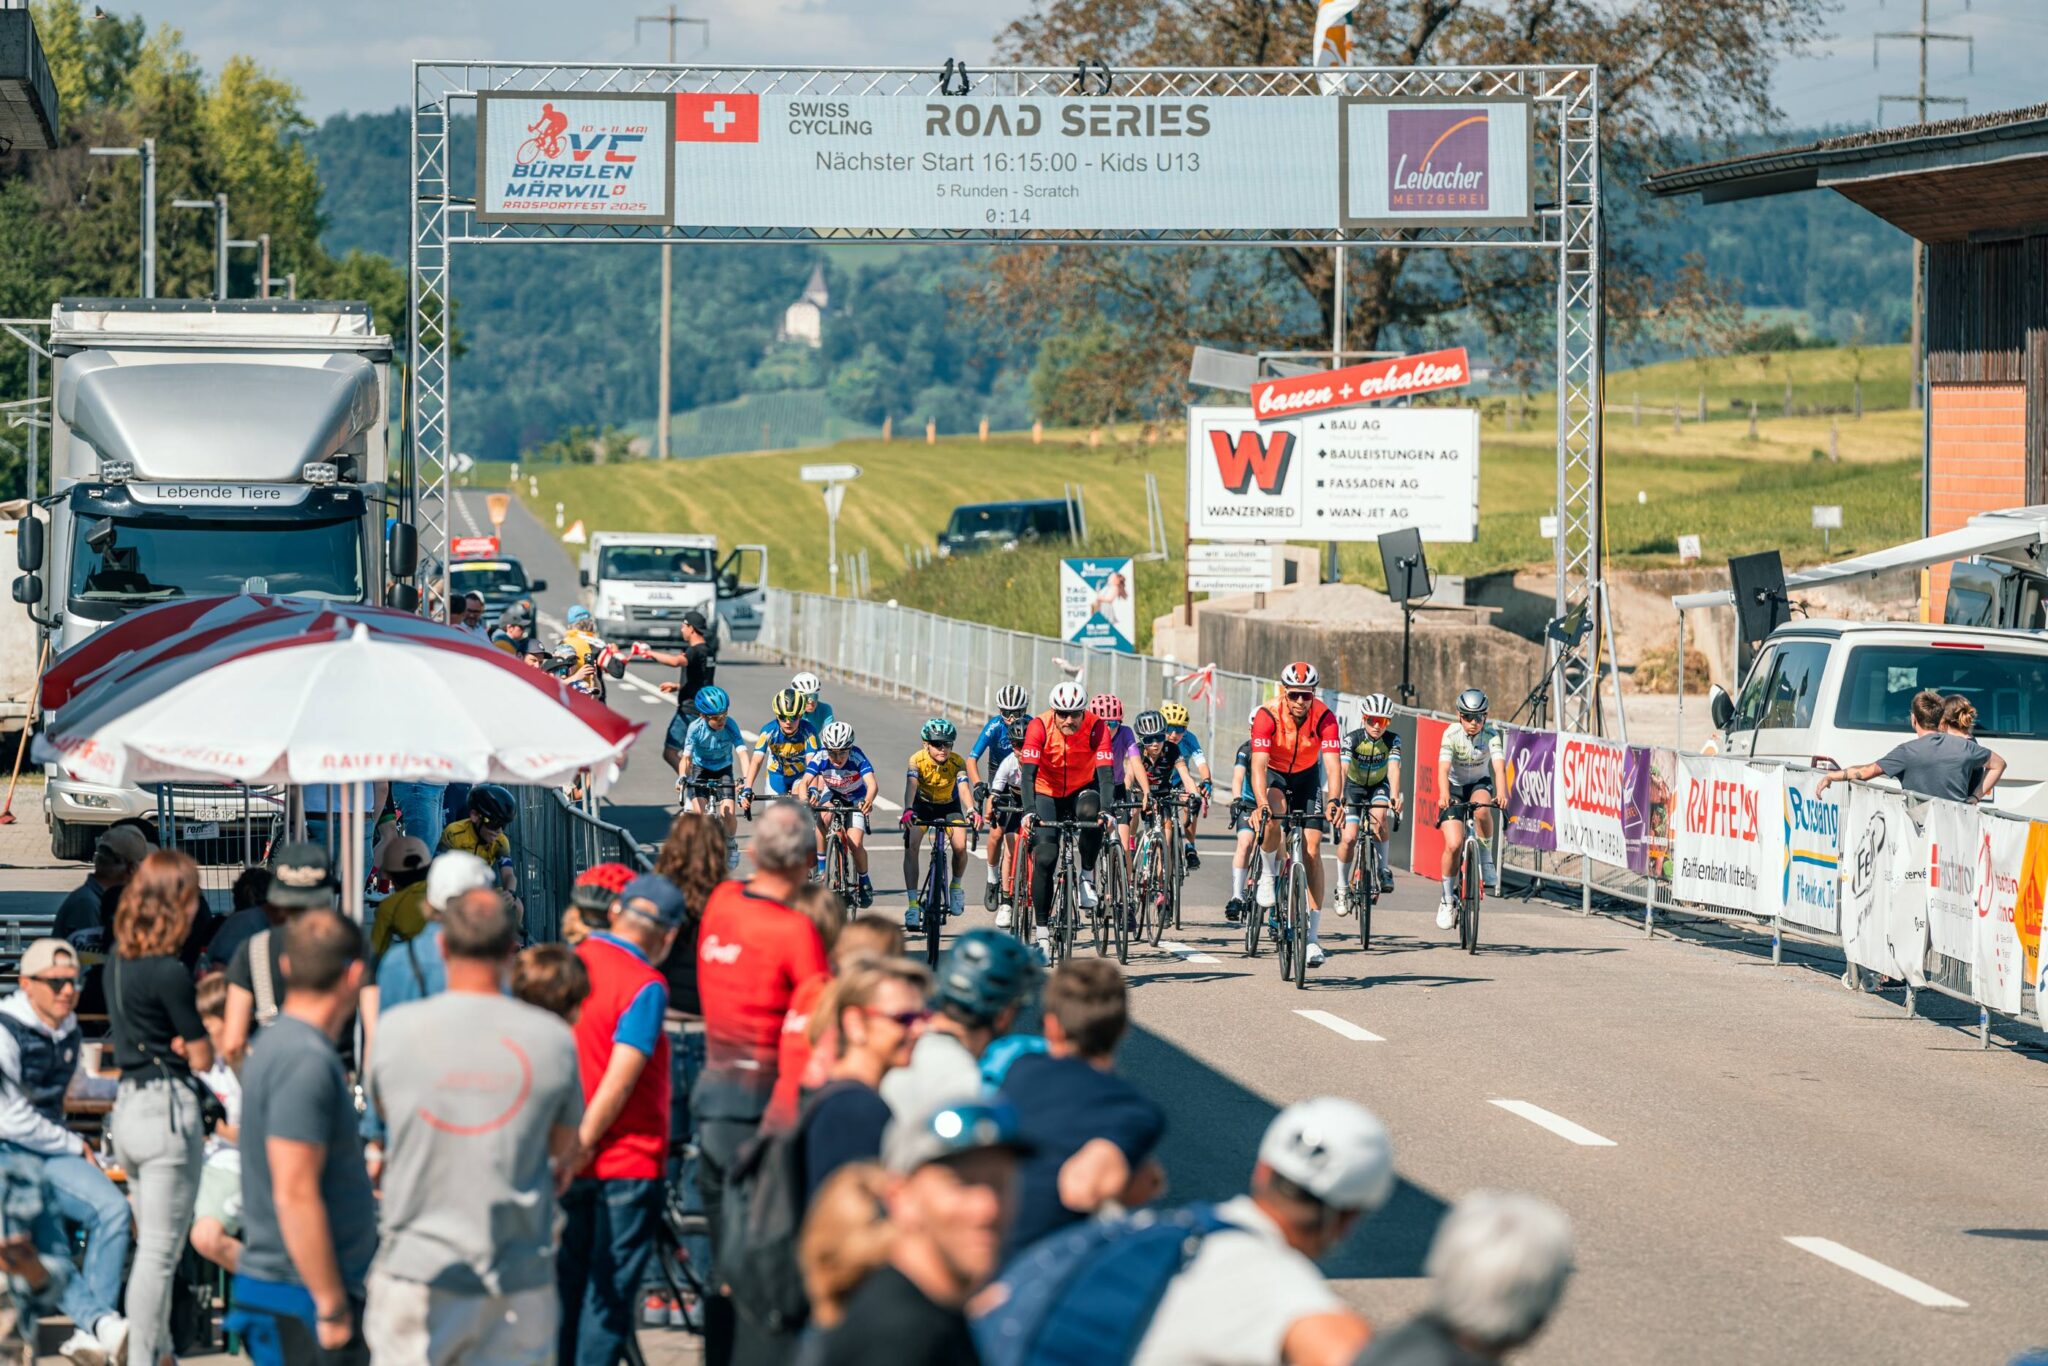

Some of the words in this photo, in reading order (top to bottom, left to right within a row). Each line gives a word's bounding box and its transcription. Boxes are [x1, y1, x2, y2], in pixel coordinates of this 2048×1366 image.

[788, 102, 850, 118] SWISS
[788, 119, 873, 136] CYCLING
[926, 103, 1042, 137] ROAD
[1060, 103, 1212, 137] SERIES
[581, 125, 594, 133] 10
[624, 126, 648, 134] MAI
[567, 133, 644, 163] VC
[815, 151, 915, 172] Nächster
[922, 152, 974, 172] Start
[983, 152, 1078, 173] 16:15:00
[1101, 152, 1148, 173] Kids
[1156, 152, 1201, 173] U13
[511, 160, 634, 180] BÜRGLEN
[1393, 153, 1484, 191] Leibacher
[504, 179, 611, 199] MÄRWIL
[936, 184, 946, 197] 5
[950, 184, 1008, 197] Runden
[1023, 184, 1080, 198] Scratch
[502, 201, 607, 211] RADSPORTFEST
[609, 202, 649, 212] 2025
[1393, 193, 1485, 205] METZGEREI
[985, 208, 1031, 224] 0:14
[1258, 381, 1334, 414] bauen
[1359, 361, 1464, 397] erhalten
[1330, 420, 1357, 430] BAU
[1362, 420, 1381, 430] AG
[1330, 449, 1435, 460] BAULEISTUNGEN
[1440, 450, 1459, 460] AG
[1329, 478, 1395, 489] FASSADEN
[1400, 479, 1419, 489] AG
[156, 486, 232, 499] Lebende
[238, 486, 281, 500] Tiere
[1207, 506, 1295, 519] WANZENRIED
[1329, 507, 1386, 518] WAN-JET
[1390, 508, 1409, 518] AG
